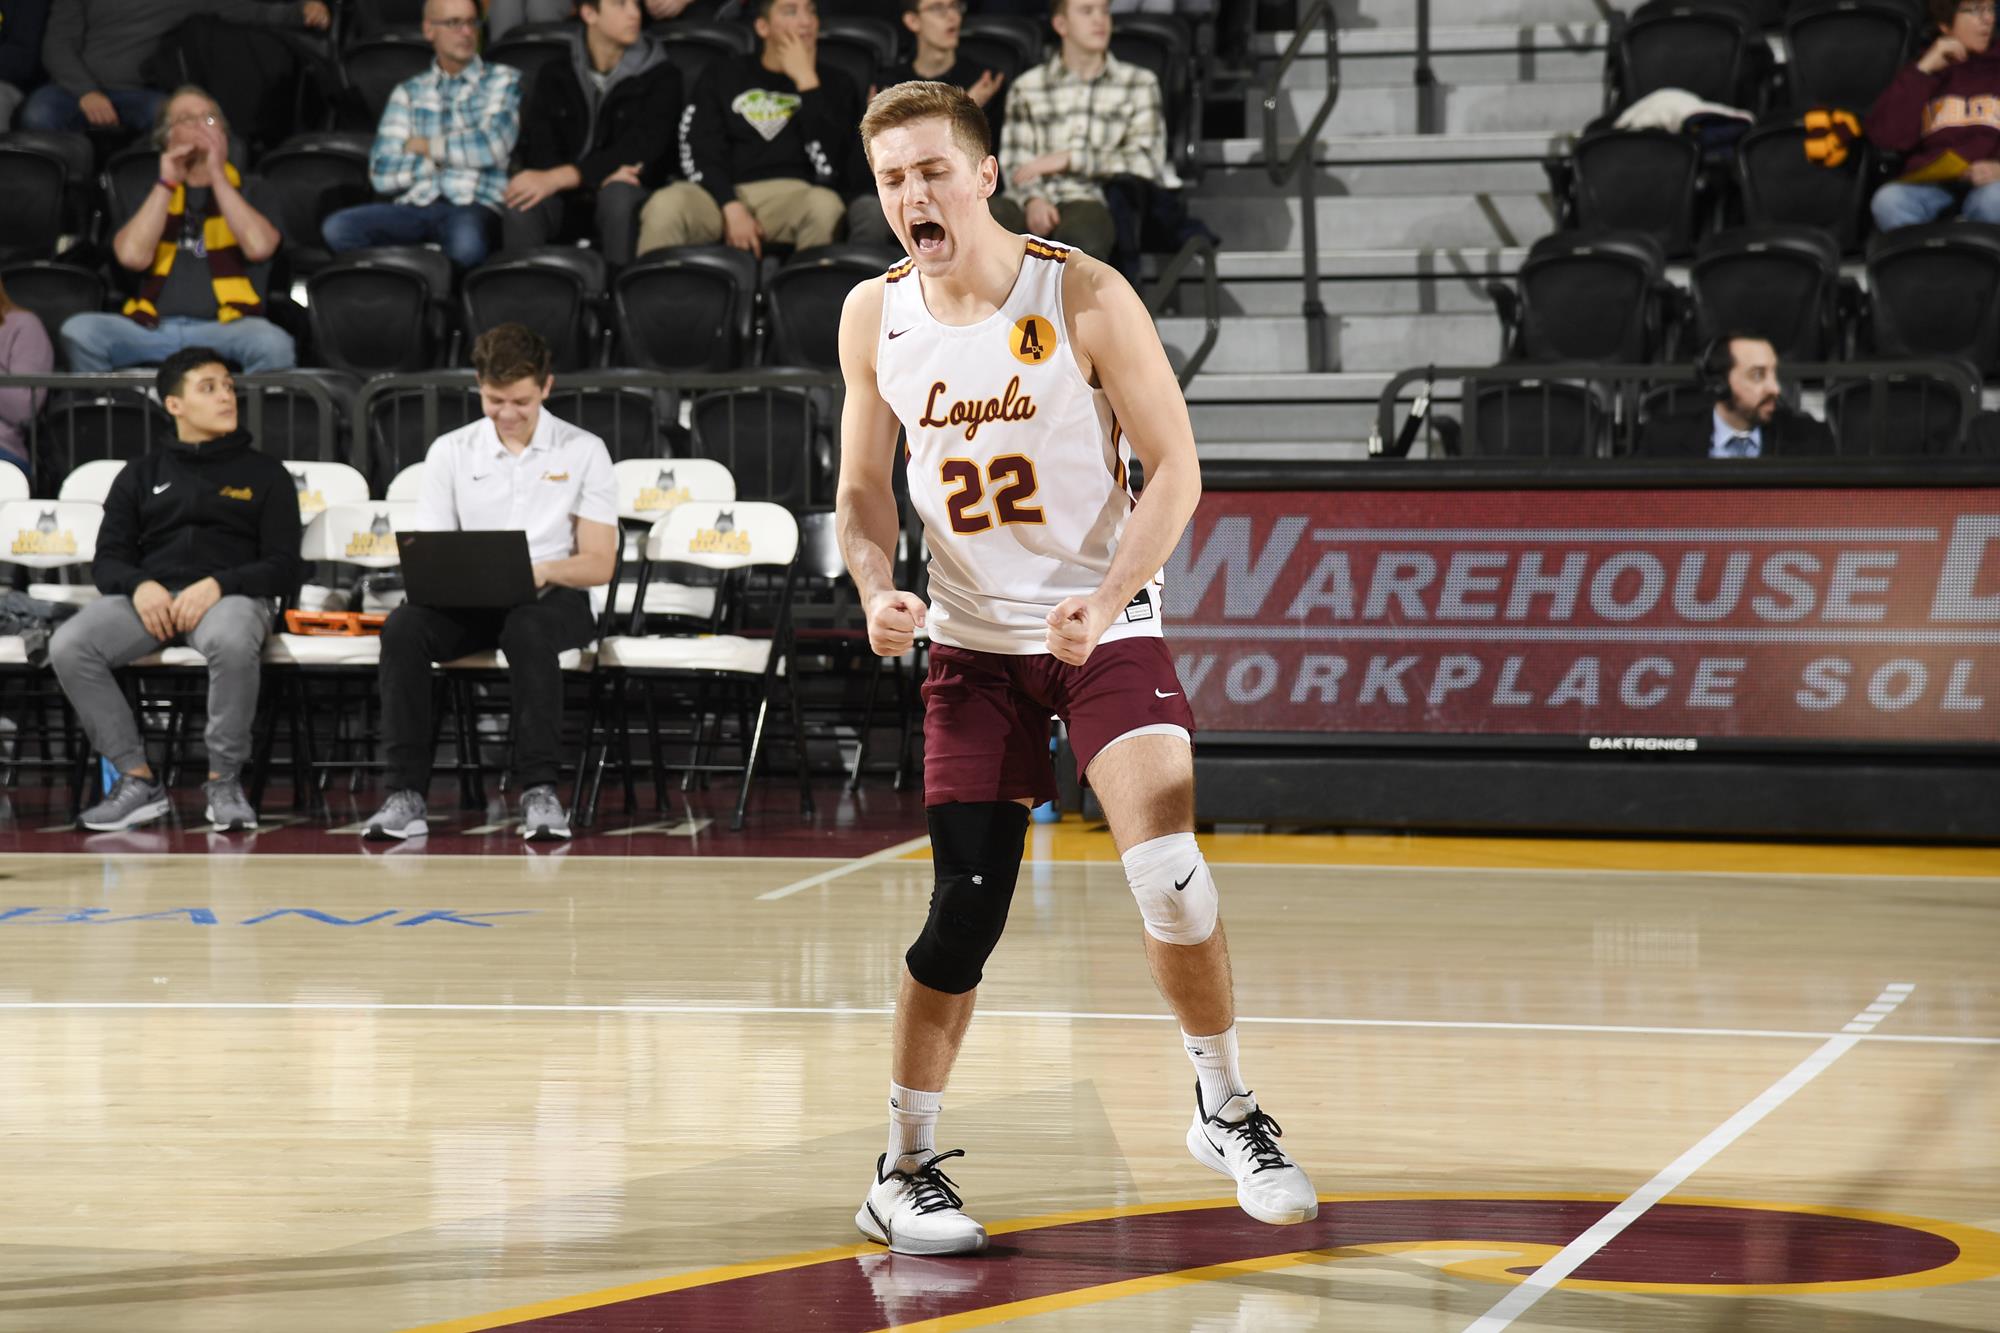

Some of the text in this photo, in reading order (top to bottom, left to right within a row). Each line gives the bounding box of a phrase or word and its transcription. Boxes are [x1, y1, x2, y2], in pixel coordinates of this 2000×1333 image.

[1020, 319, 1044, 360] 4
[919, 375, 1037, 441] Loyola
[939, 453, 1047, 536] 22
[1795, 656, 1986, 712] SOL
[1589, 737, 1698, 751] DAKTRONICS
[0, 906, 545, 927] BANK
